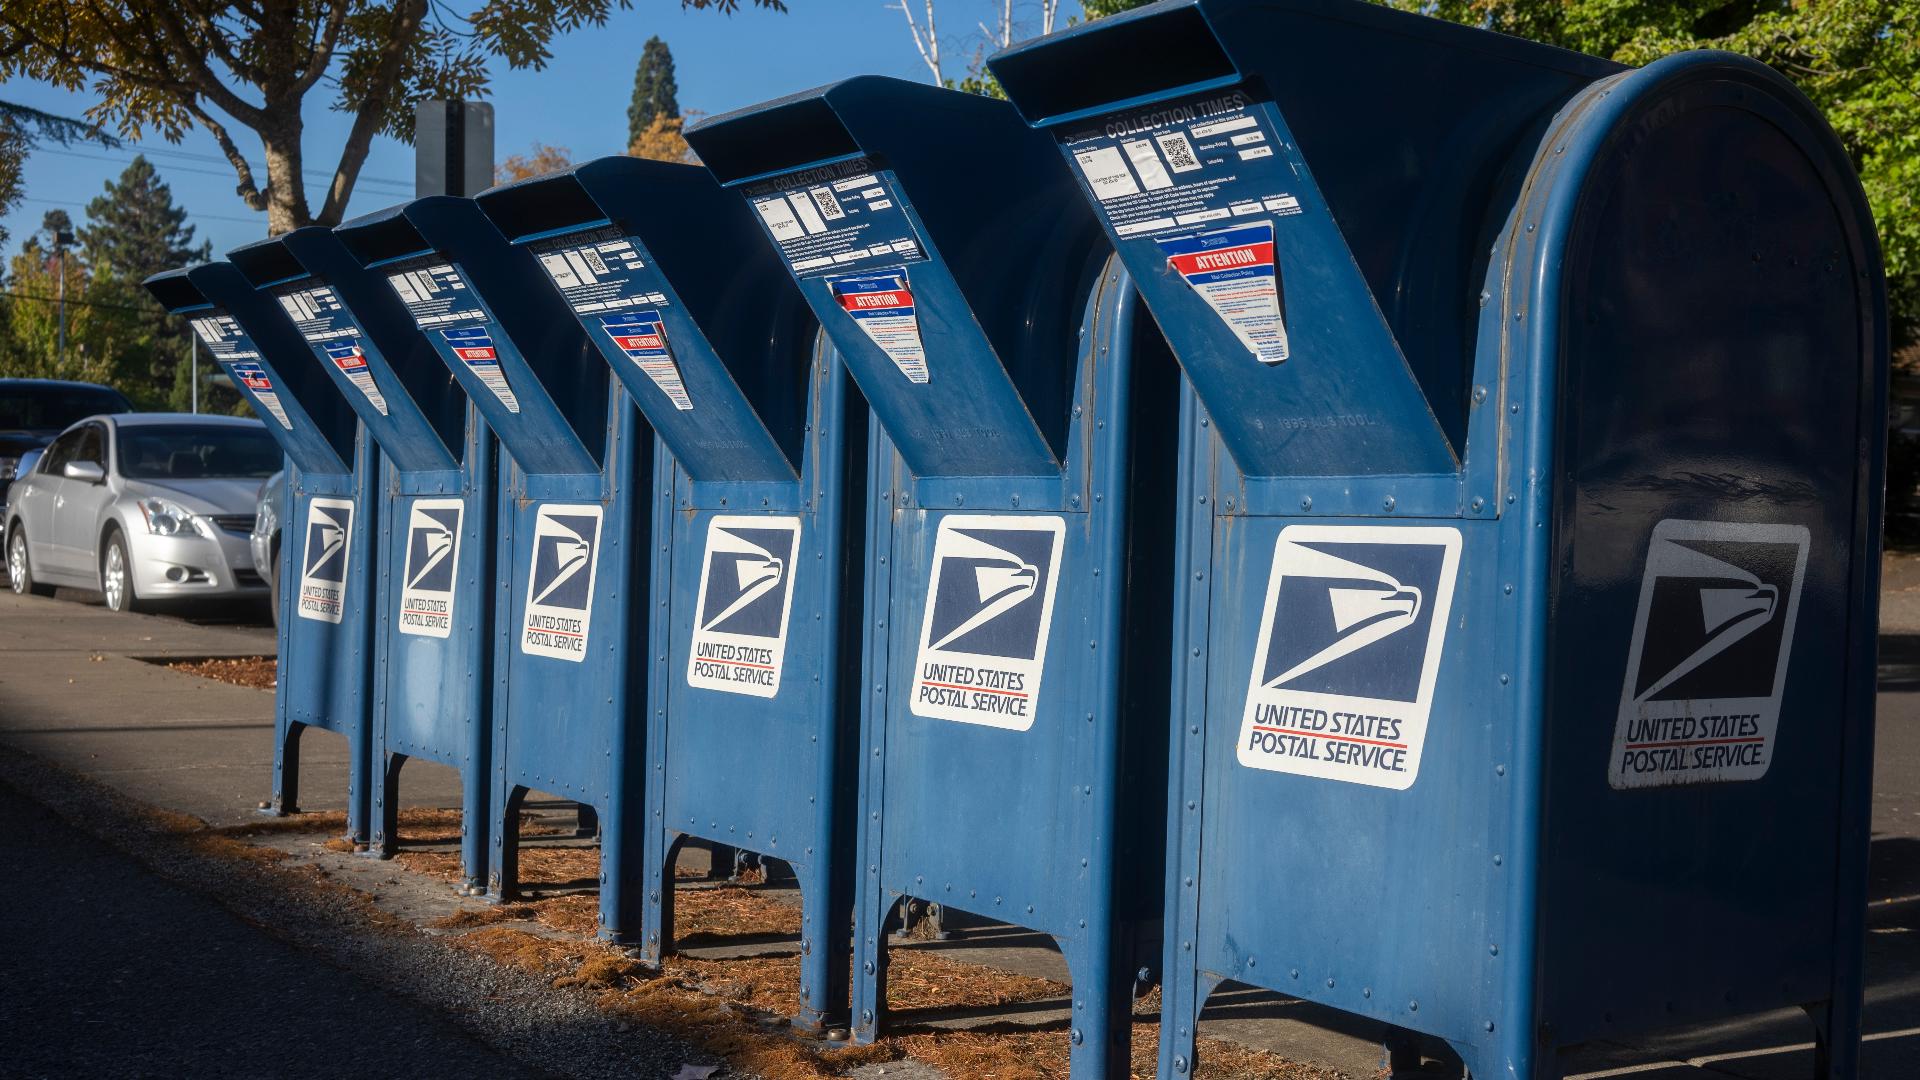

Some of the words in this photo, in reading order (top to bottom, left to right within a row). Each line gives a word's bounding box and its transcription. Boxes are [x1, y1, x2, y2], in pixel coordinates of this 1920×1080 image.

[1105, 106, 1196, 138] COLLECTION
[1201, 94, 1245, 116] TIMES
[774, 167, 836, 191] COLLECTION
[838, 158, 868, 176] TIMES
[1196, 249, 1256, 270] ATTENTION
[855, 294, 899, 307] ATTENTION
[628, 338, 660, 347] ATTENTION
[304, 586, 321, 598] UNITED
[322, 588, 339, 600] STATES
[302, 599, 319, 611] POSTAL
[405, 598, 426, 610] UNITED
[427, 600, 447, 612] STATES
[403, 614, 424, 626] POSTAL
[425, 616, 448, 628] SERVICE
[528, 614, 555, 629] UNITED
[556, 618, 581, 633] STATES
[527, 631, 552, 647] POSTAL
[554, 635, 582, 651] SERVICE
[698, 642, 735, 660] UNITED
[736, 647, 772, 664] STATES
[694, 662, 730, 680] POSTAL
[733, 667, 774, 686] SERVICE
[924, 663, 974, 684] UNITED
[976, 669, 1024, 690] STATES
[920, 686, 968, 708] POSTAL
[971, 693, 1028, 716] SERVICE
[1254, 704, 1328, 731] UNITED
[1330, 712, 1402, 740] STATES
[1627, 718, 1696, 742] UNITED
[1700, 714, 1760, 738] STATES
[1249, 731, 1319, 760] POSTAL
[1324, 741, 1407, 772] SERVICE
[1621, 749, 1688, 774] POSTAL
[1692, 744, 1764, 769] SERVICE
